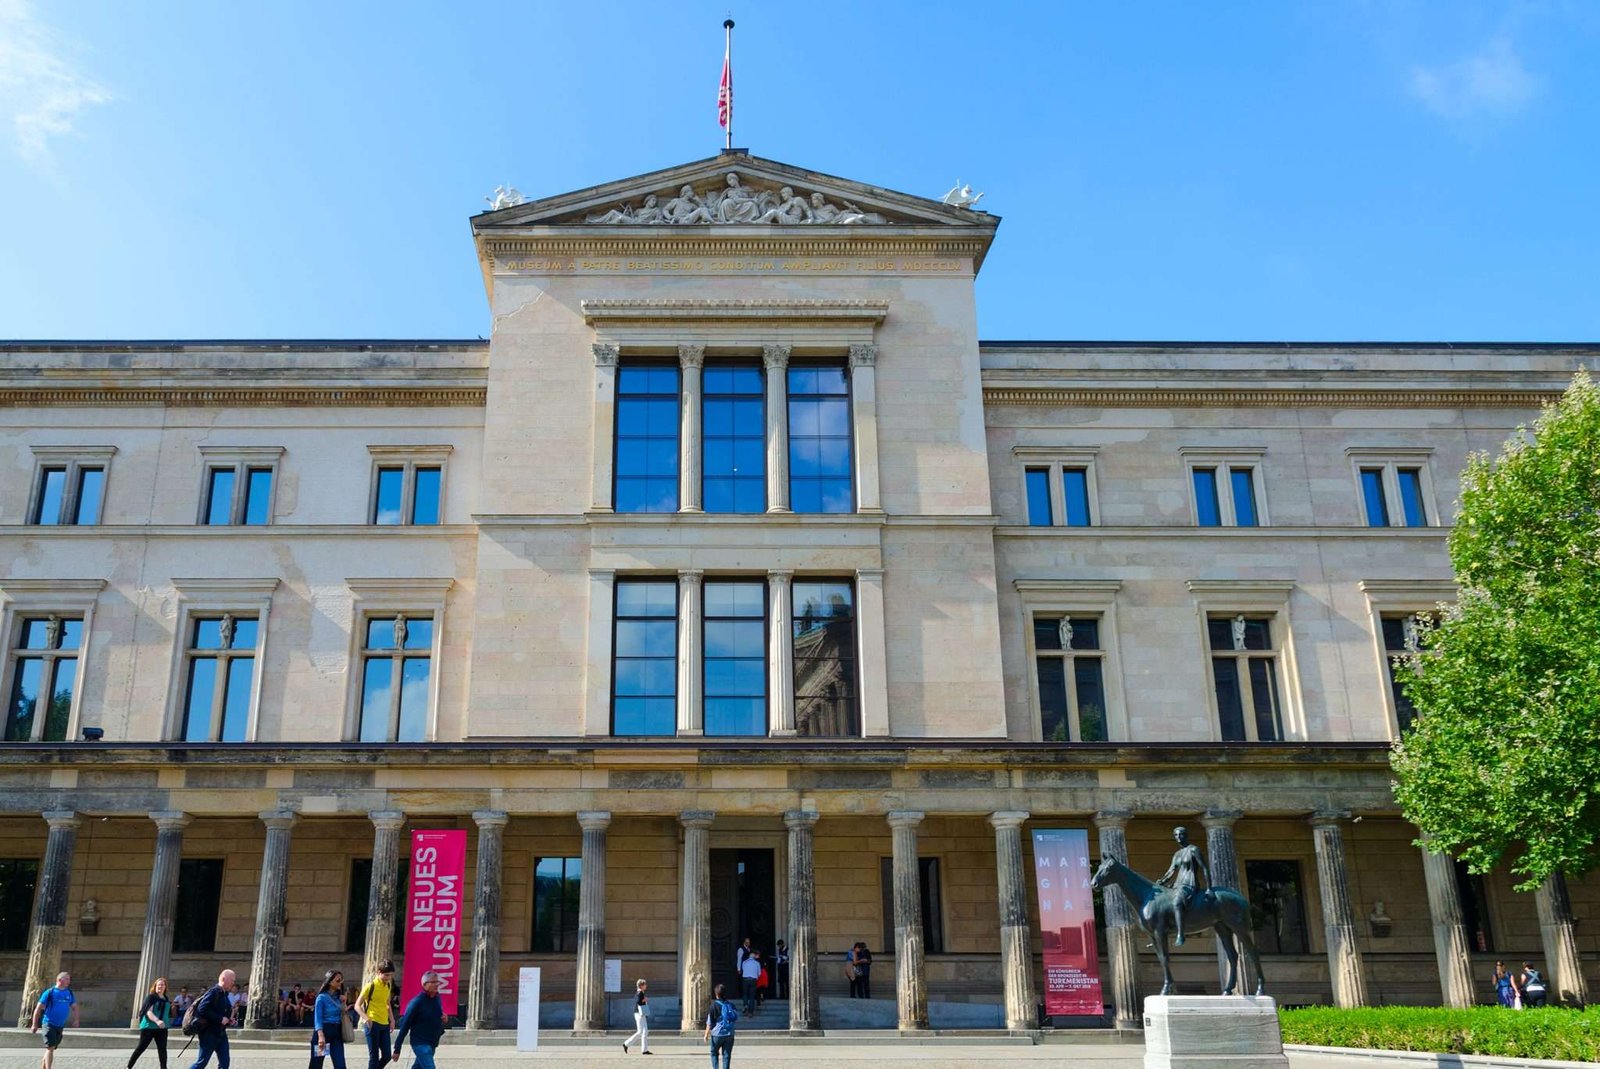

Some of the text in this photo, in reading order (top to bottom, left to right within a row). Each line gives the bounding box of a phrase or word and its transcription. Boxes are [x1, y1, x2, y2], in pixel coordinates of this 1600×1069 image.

[506, 261, 562, 270] MUSEUM
[567, 261, 576, 270] A
[581, 261, 619, 270] PATRE
[627, 261, 704, 270] BEATISSIMO
[782, 261, 849, 270] AMPLIAVIT
[413, 847, 437, 932] NEUES
[433, 875, 458, 994] MUSEUM
